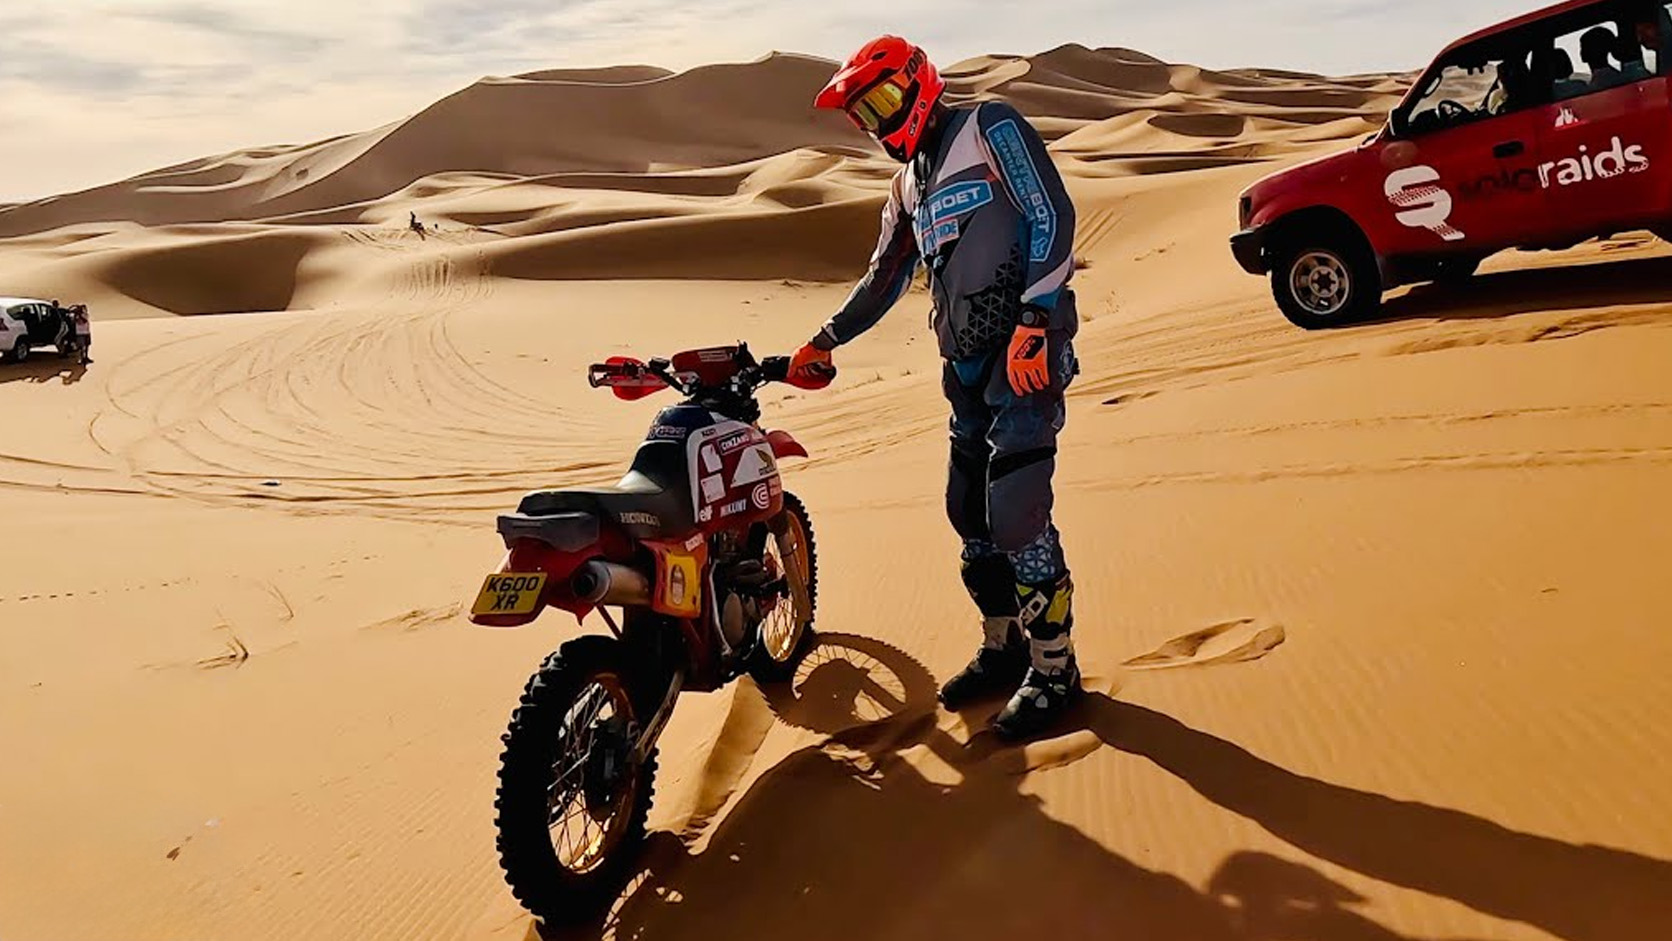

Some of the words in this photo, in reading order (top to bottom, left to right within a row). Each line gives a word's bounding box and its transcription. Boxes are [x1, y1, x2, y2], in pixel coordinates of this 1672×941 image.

[699, 505, 713, 522] elf
[486, 577, 540, 593] K600
[491, 593, 520, 610] XR
